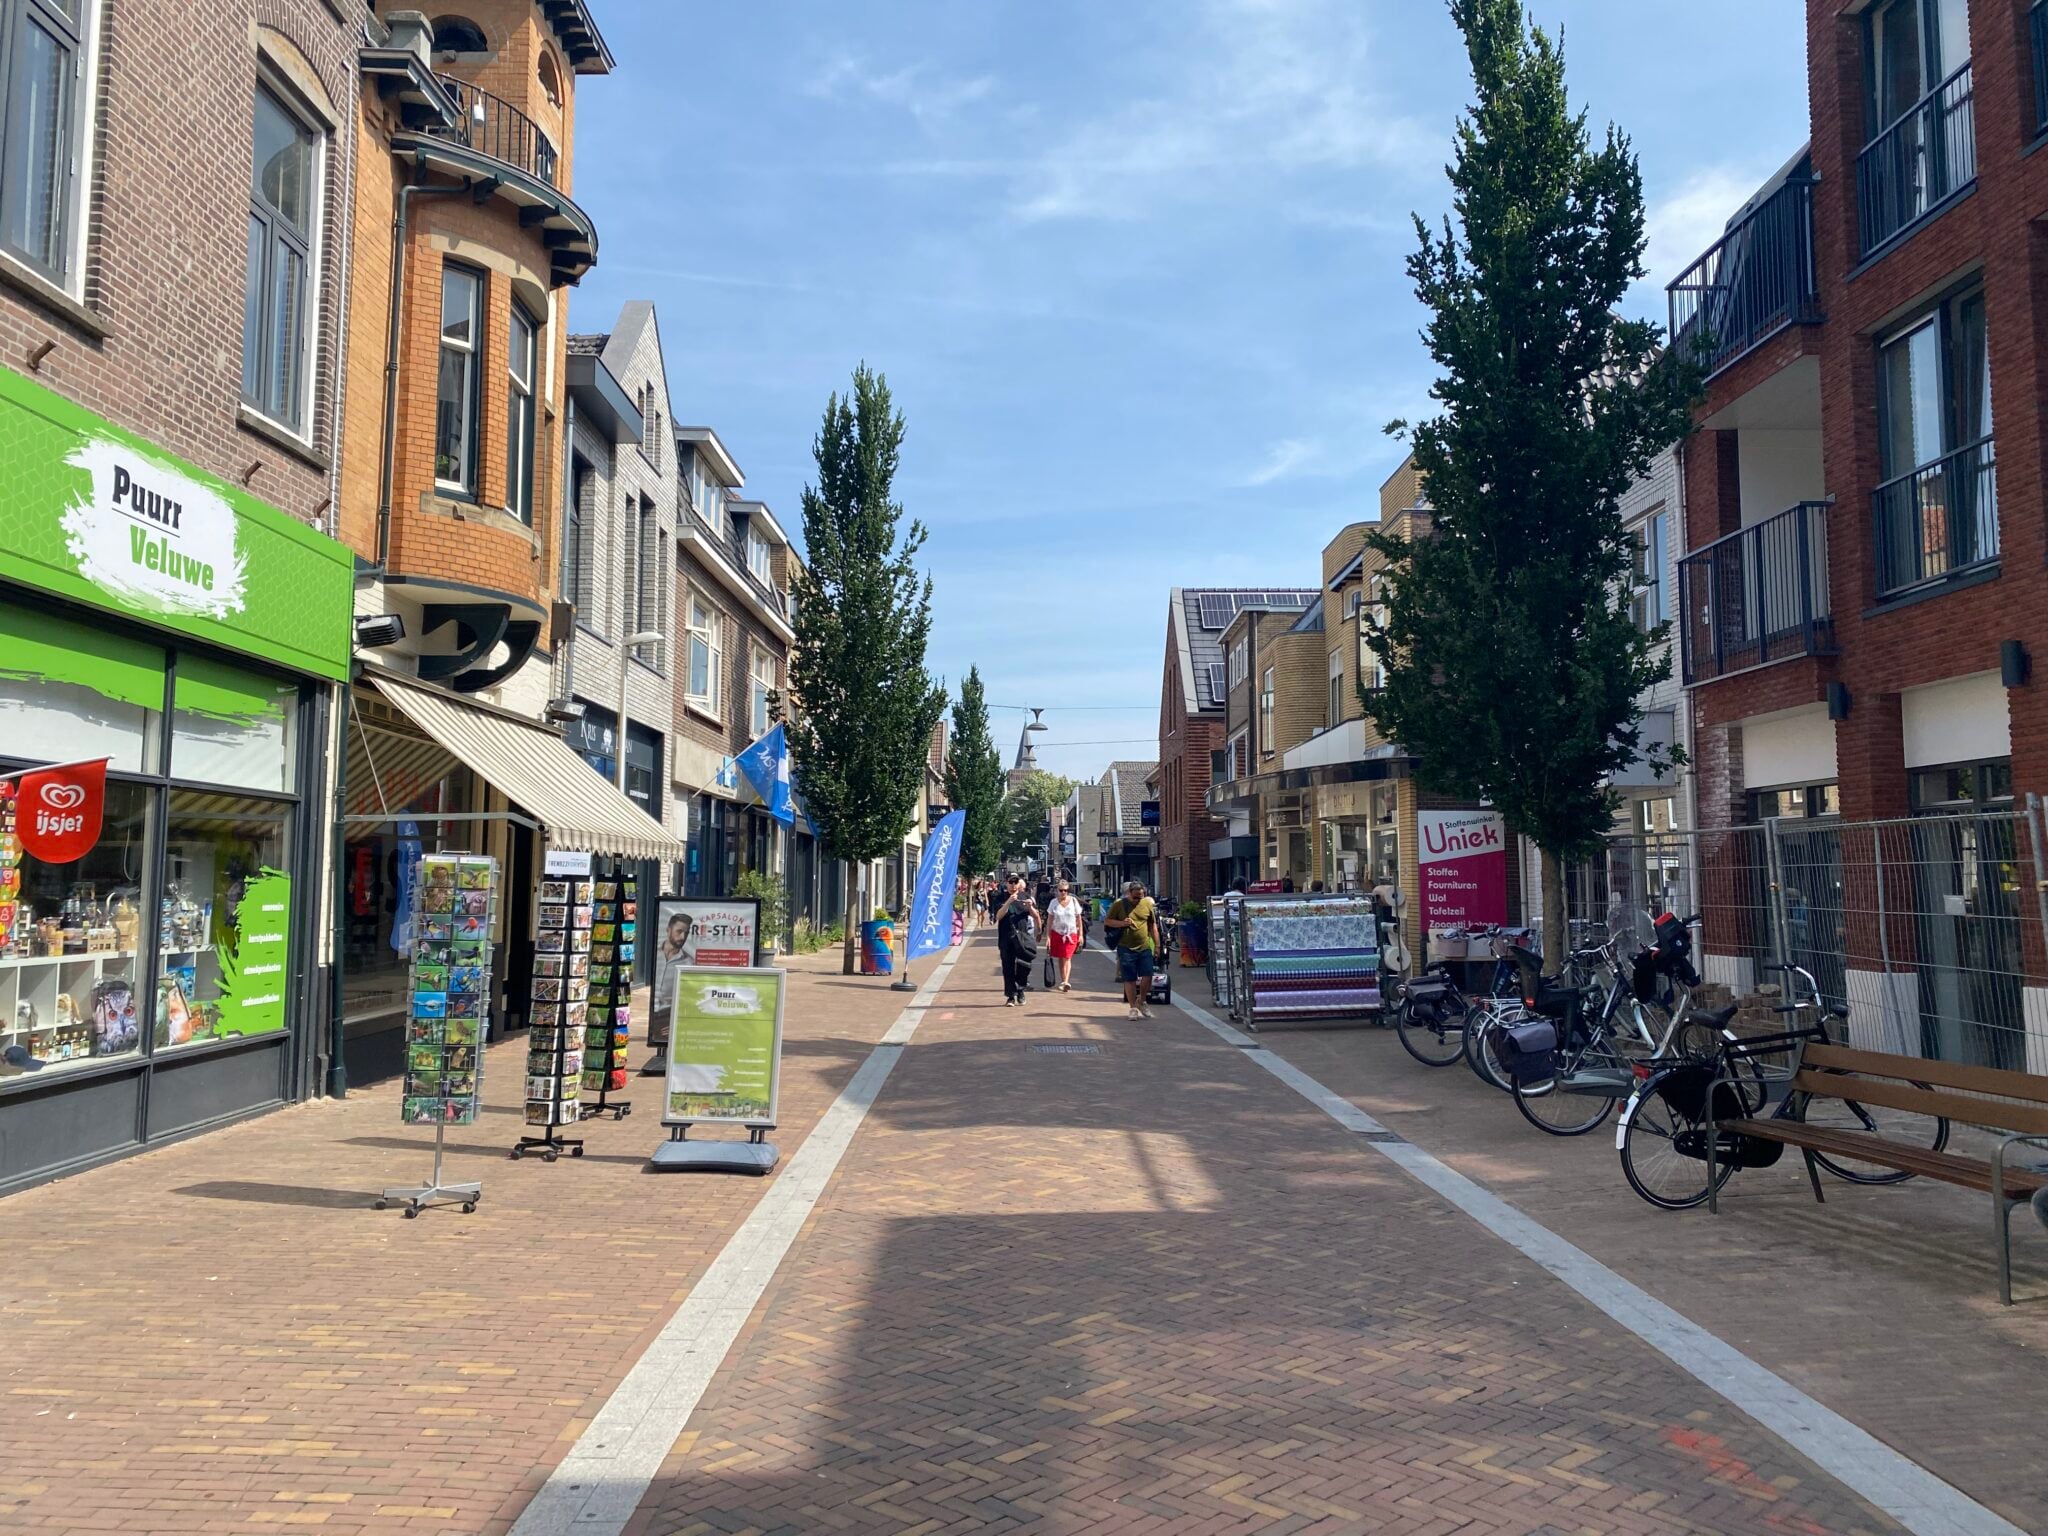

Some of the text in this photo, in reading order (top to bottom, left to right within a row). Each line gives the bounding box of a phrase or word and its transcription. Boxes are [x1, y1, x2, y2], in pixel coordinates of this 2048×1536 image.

[112, 465, 182, 530] Puurr
[130, 525, 214, 591] Veluwe
[36, 809, 84, 836] ijsje?
[1445, 814, 1496, 829] Stoffenwinkel
[1424, 822, 1499, 854] Uniek
[1427, 867, 1459, 877] Stoffen
[923, 824, 953, 935] Sportpodologie
[1428, 881, 1478, 890] Fournituren
[1428, 894, 1447, 903] Wol
[1428, 907, 1465, 916] Tafelzeil
[699, 912, 745, 924] KAPSALON
[711, 989, 736, 999] Puurr
[717, 1000, 749, 1009] Veluwe
